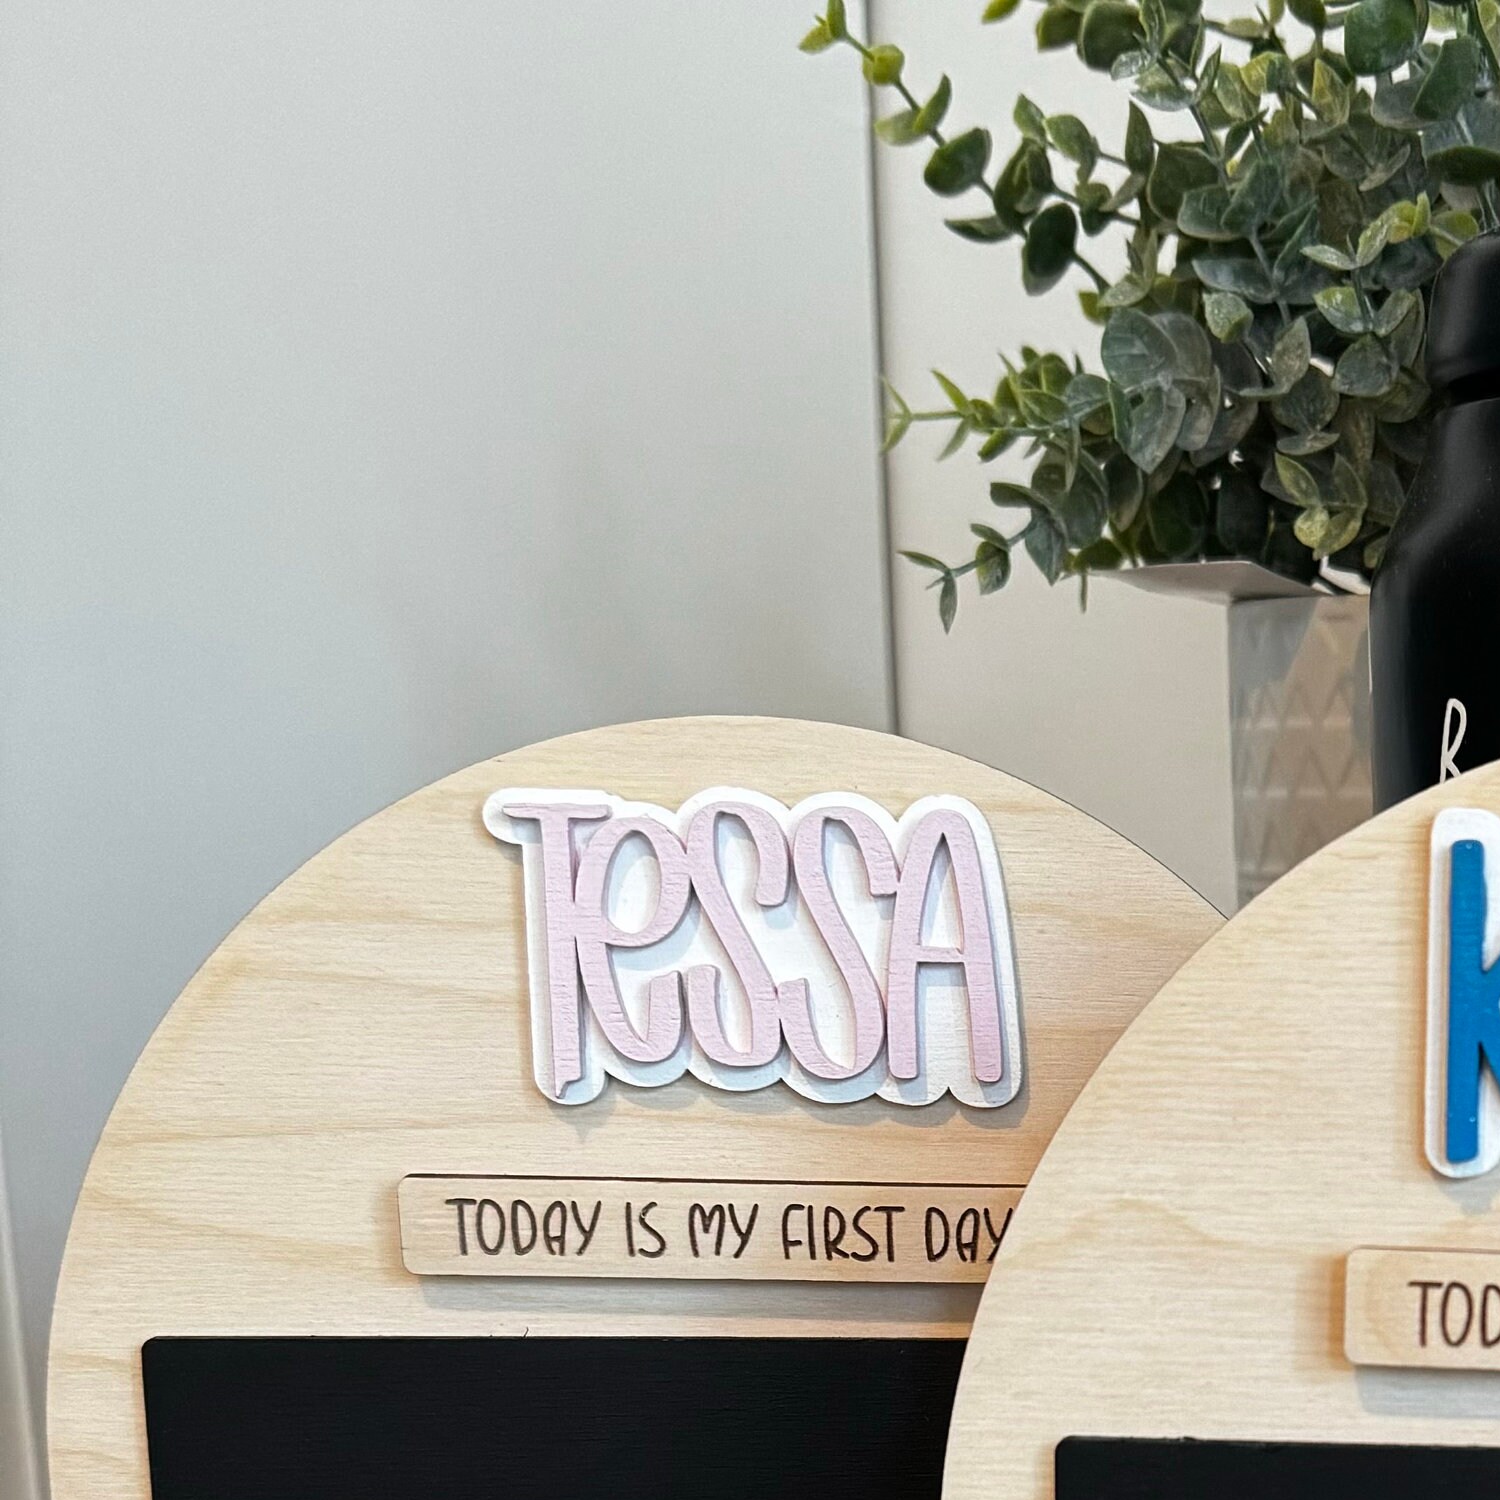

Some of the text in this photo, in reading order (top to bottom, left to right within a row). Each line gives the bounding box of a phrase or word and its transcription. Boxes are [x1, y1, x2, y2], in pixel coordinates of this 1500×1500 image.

[445, 1196, 1015, 1263] TODAY IS MY FIRST DAY
